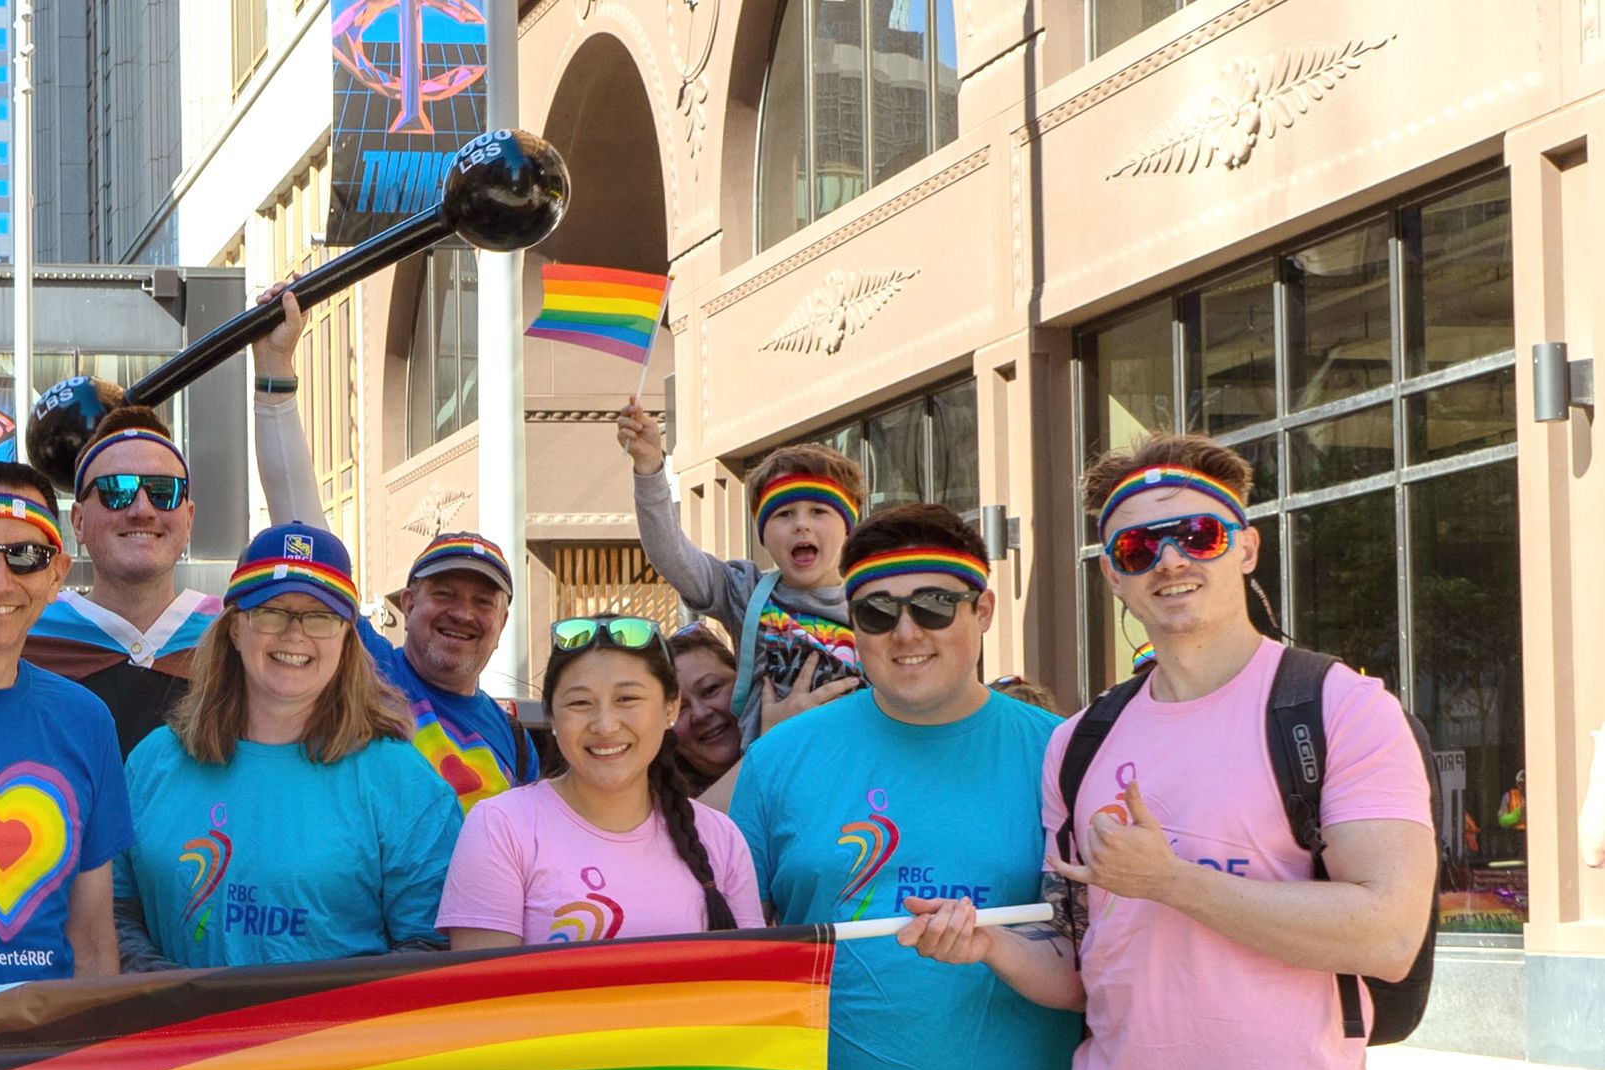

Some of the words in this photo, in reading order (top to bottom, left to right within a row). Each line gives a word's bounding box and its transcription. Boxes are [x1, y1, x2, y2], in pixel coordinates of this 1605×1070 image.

[458, 142, 502, 175] LBS
[36, 388, 74, 421] LBS
[1292, 723, 1319, 784] OGIO
[898, 866, 935, 884] RBC
[227, 883, 258, 901] RBC
[225, 903, 310, 937] PRIDE
